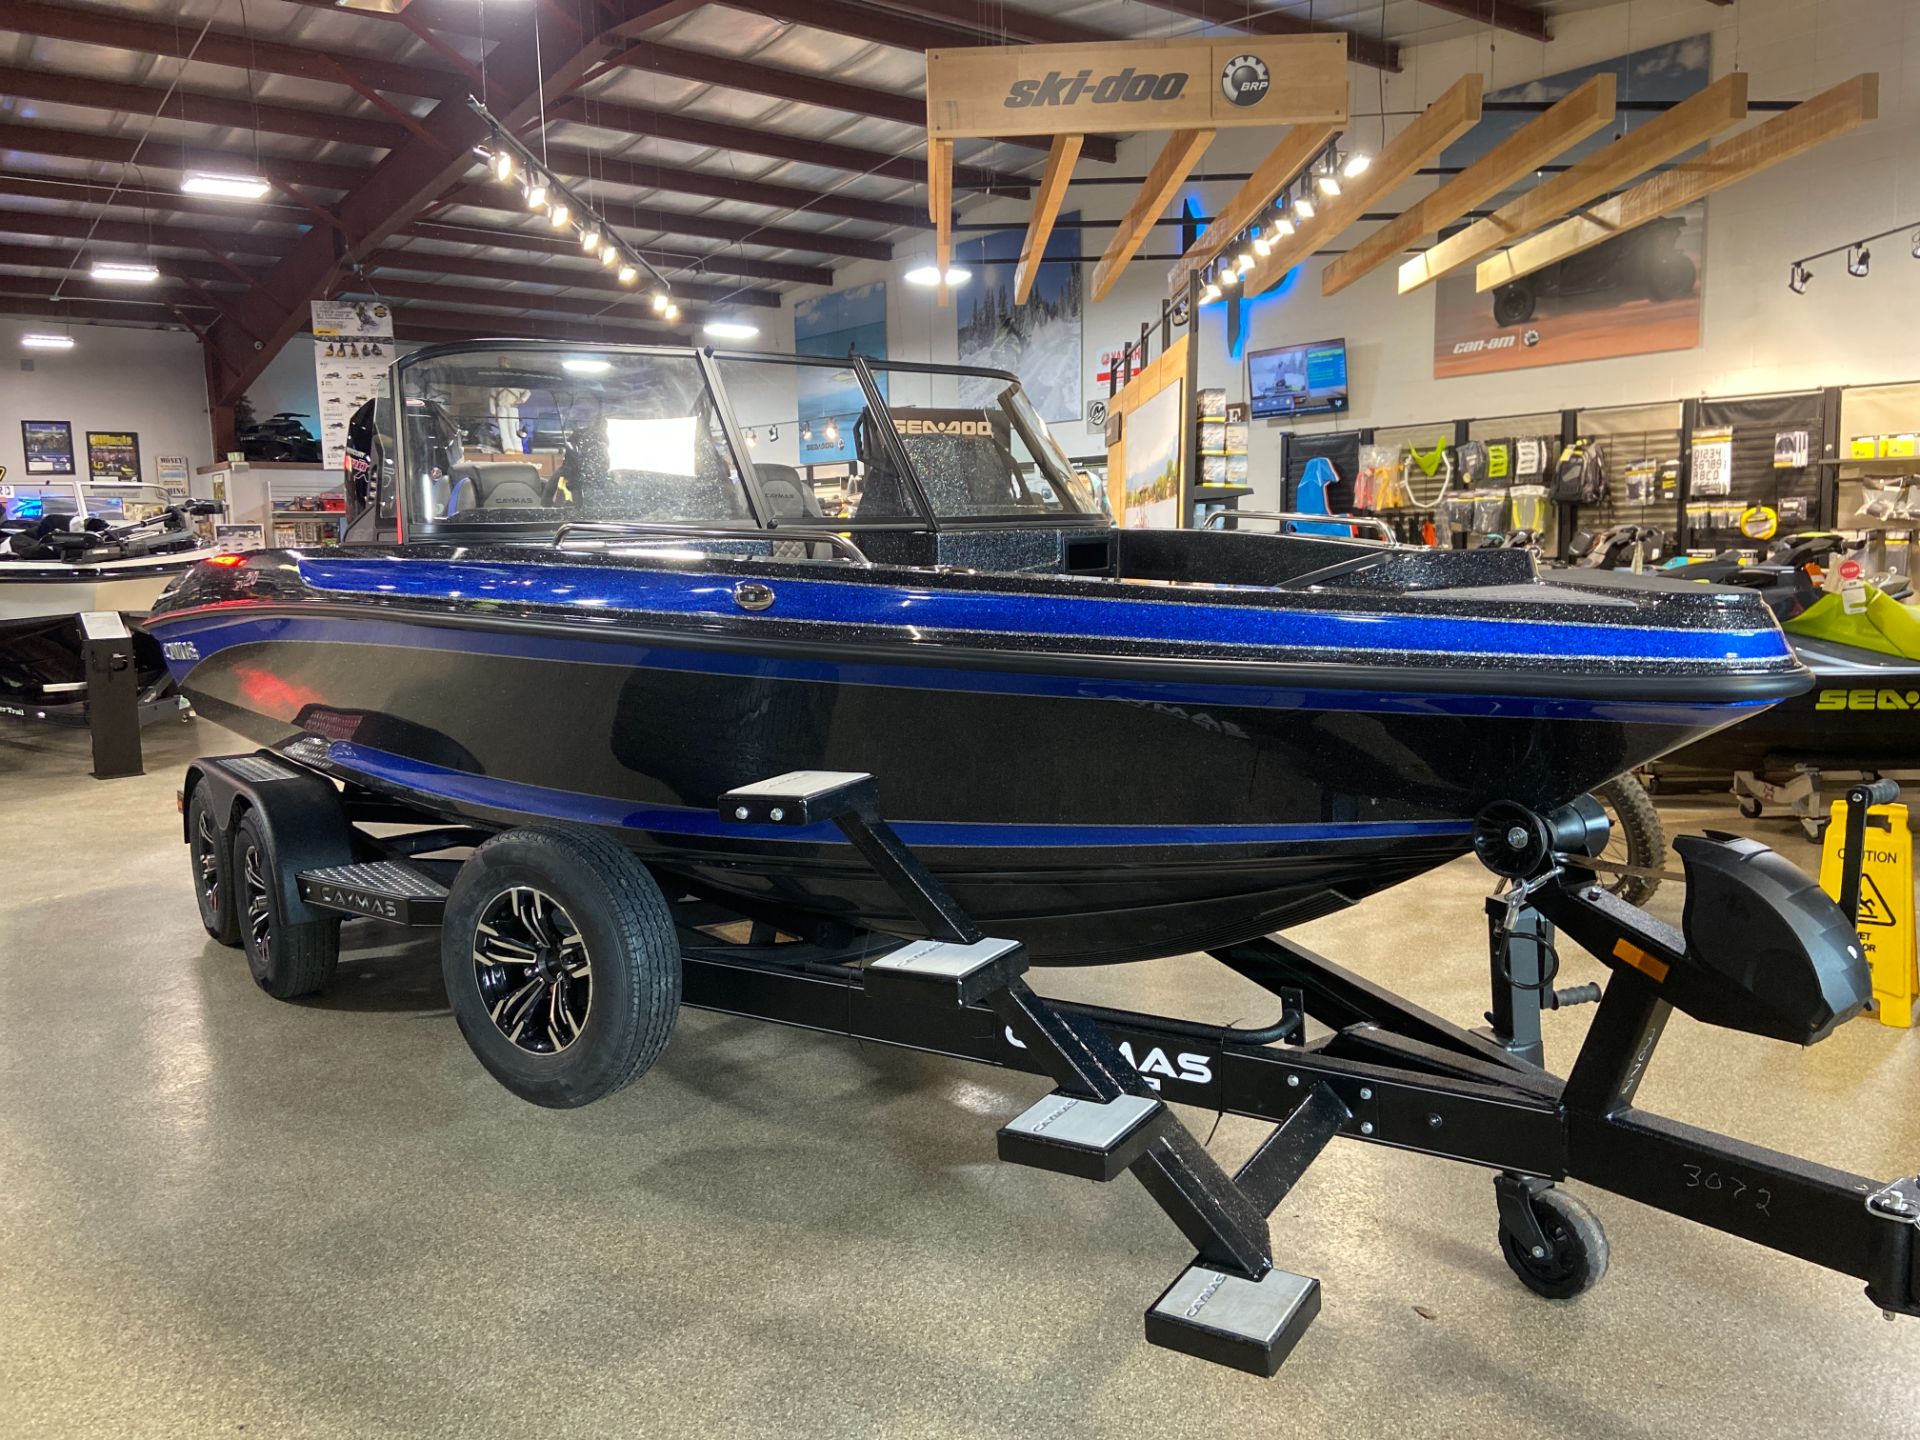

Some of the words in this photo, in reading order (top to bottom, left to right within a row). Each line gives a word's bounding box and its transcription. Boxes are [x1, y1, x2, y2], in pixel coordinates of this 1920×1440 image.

[1004, 67, 1189, 108] ski-doo
[1240, 80, 1270, 92] BRP
[1453, 335, 1515, 354] can-am
[1837, 848, 1897, 864] CTION
[321, 887, 397, 917] CAYMAS
[1858, 931, 1871, 941] ET
